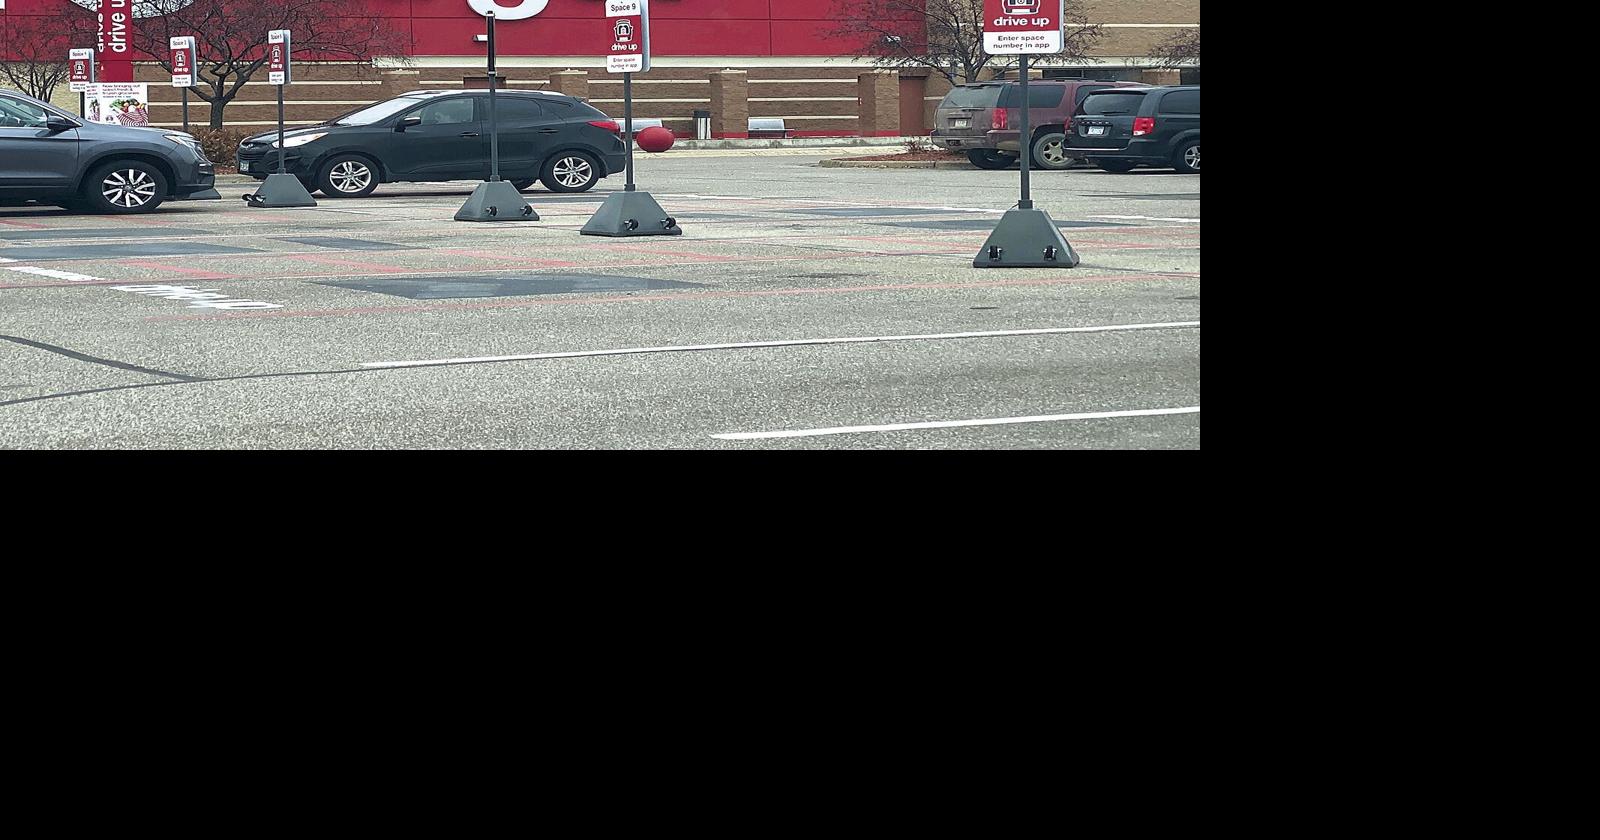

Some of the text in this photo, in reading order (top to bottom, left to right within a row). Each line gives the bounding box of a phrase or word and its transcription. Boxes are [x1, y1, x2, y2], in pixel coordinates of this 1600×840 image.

[610, 4, 631, 13] Space
[993, 16, 1050, 28] drive up
[106, 12, 127, 53] drive
[1020, 35, 1045, 43] space
[611, 43, 638, 52] drive up
